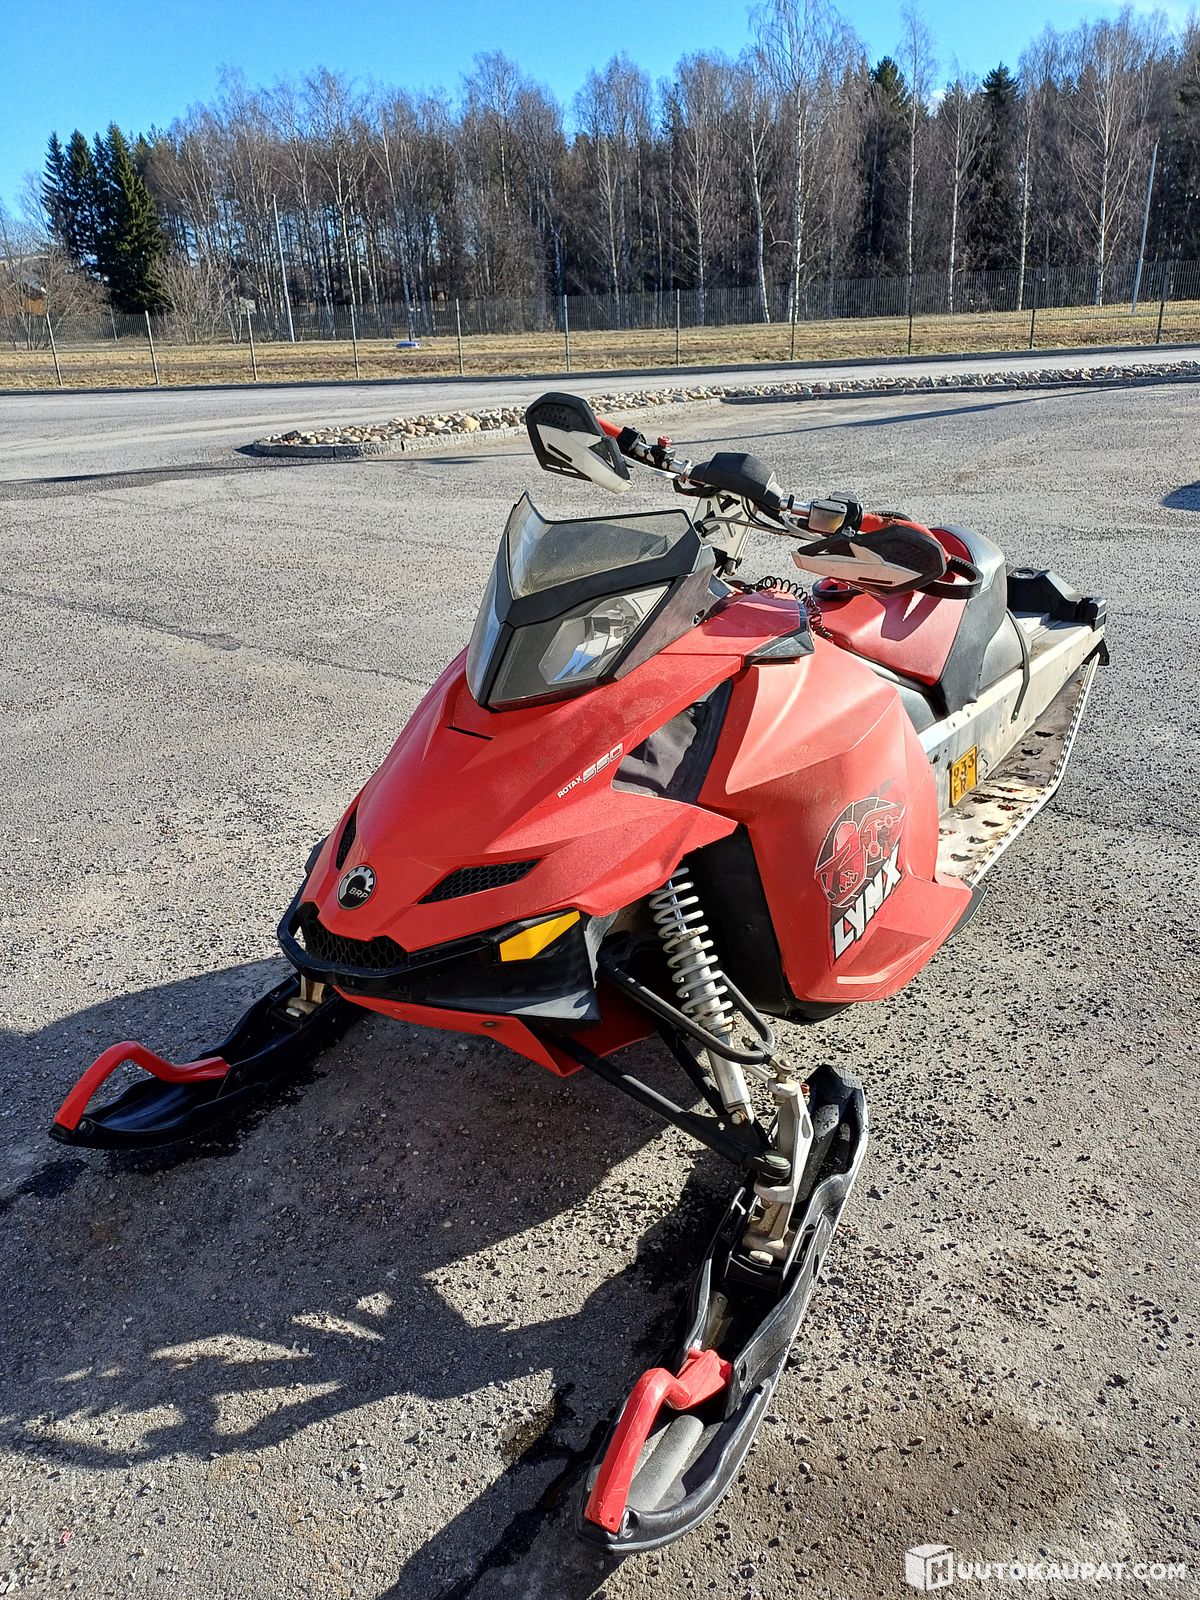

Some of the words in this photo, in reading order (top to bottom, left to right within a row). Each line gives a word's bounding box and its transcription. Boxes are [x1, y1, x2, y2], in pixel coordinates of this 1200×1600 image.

[557, 775, 583, 798] ROTAX
[582, 742, 623, 783] 550
[953, 753, 975, 780] 933
[349, 886, 369, 899] BRP
[833, 842, 902, 960] LYNX
